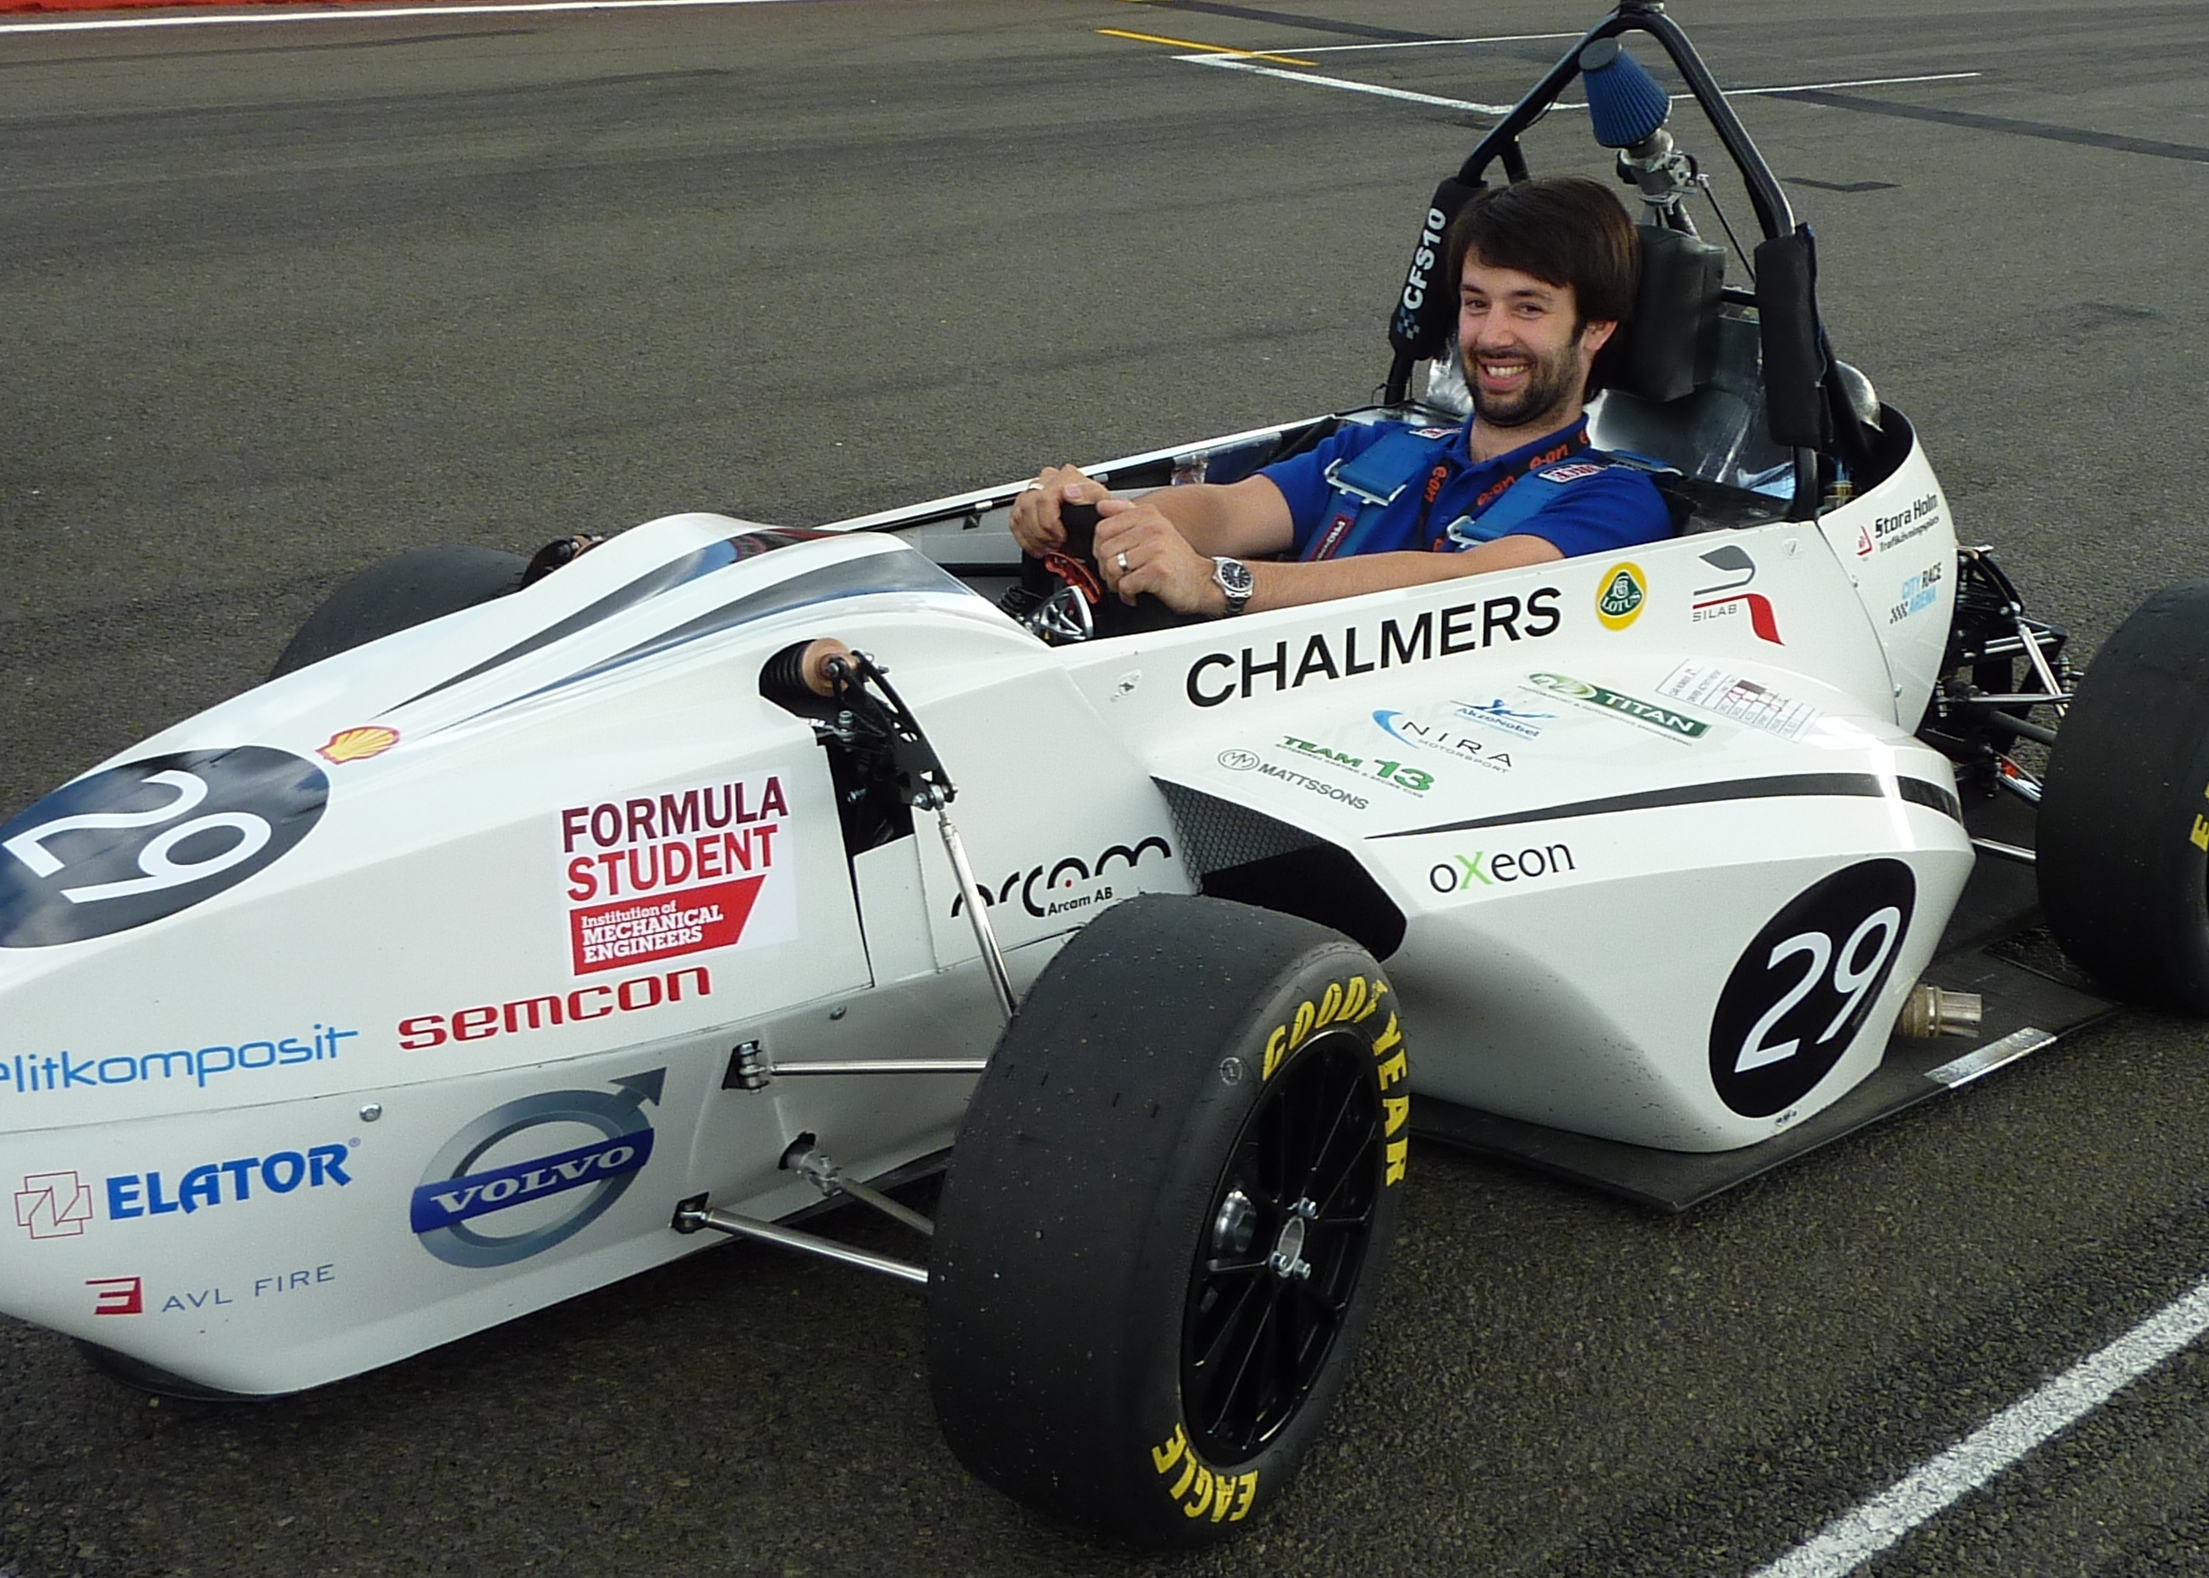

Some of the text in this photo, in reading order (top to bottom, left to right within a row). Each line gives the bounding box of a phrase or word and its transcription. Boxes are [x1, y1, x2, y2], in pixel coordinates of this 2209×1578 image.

[1402, 207, 1446, 310] CFS10
[1875, 493, 1939, 539] Stora Holm
[1692, 604, 1737, 622] SILAB
[1186, 587, 1562, 707] CHALMERS
[1456, 707, 1540, 738] AkzoNobel
[1604, 692, 1694, 733] TITAN
[1283, 735, 1435, 791] TEAM 13
[1401, 721, 1512, 768] NIRA
[1257, 763, 1369, 810] MATTSSONS
[2, 769, 272, 904] 29
[561, 776, 789, 853] FORMULA
[566, 824, 779, 902] STUDENT
[581, 900, 678, 929] Institution of
[582, 904, 724, 946] MECHANICAL
[1047, 886, 1113, 916] Arcam AB
[584, 926, 703, 963] ENGINEERS
[398, 966, 712, 1051] semcon
[1733, 906, 1901, 1073] 29
[430, 1146, 635, 1214] VOLVO
[161, 1264, 336, 1313] AVL FIRE
[1151, 1422, 1259, 1523] EAGLE
